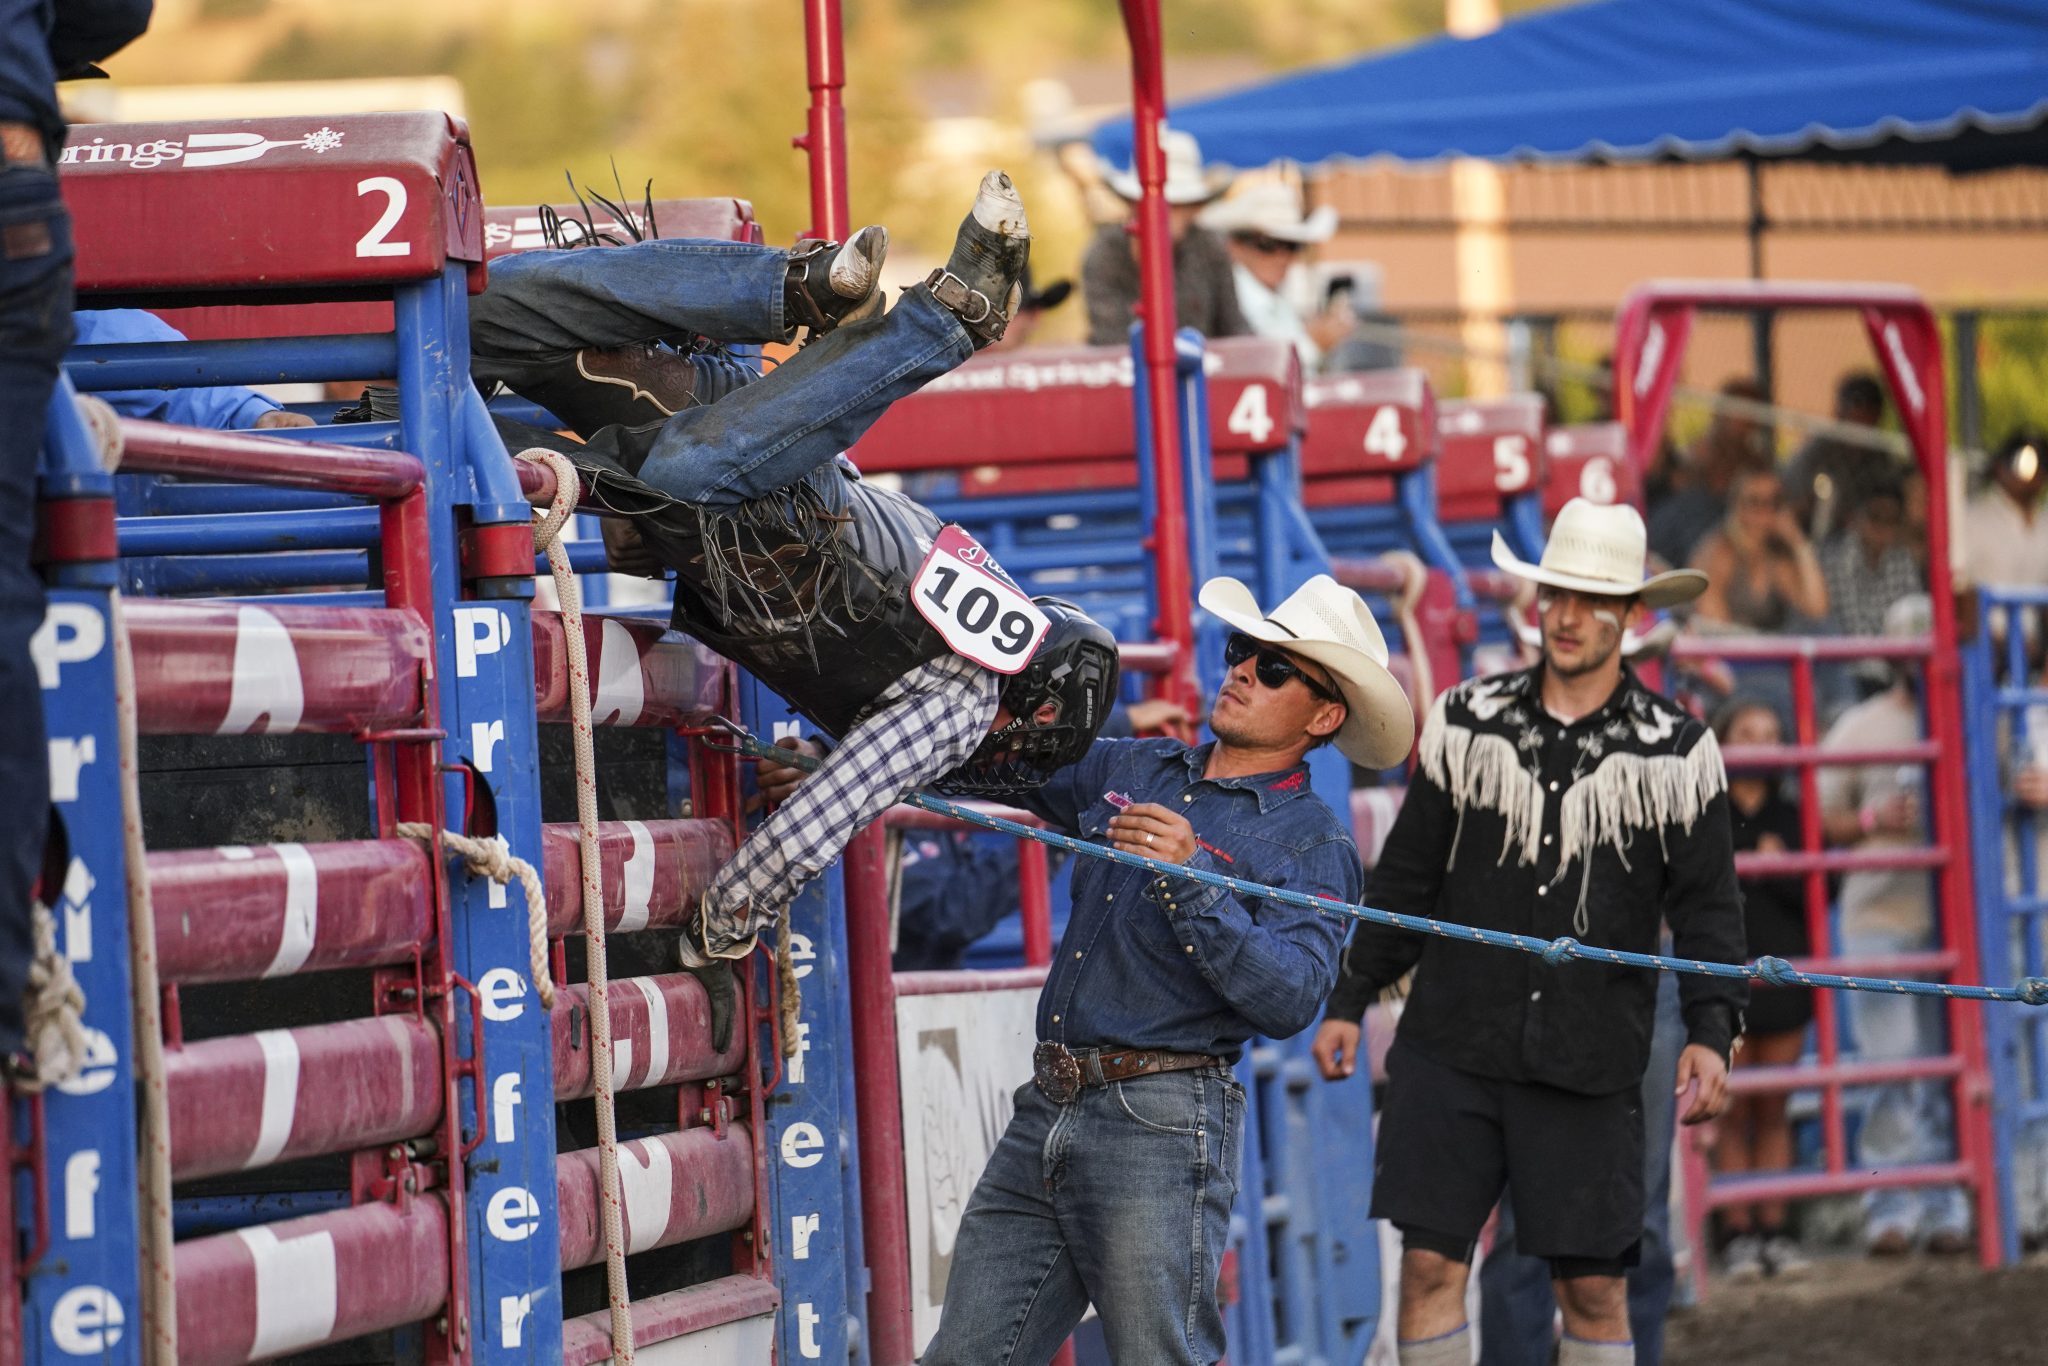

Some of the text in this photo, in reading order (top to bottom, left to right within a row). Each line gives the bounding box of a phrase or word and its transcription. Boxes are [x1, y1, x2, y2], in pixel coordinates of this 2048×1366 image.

[355, 177, 411, 258] 2
[1228, 384, 1274, 442] 4
[1364, 405, 1408, 461] 4
[1493, 435, 1530, 491] 5
[1579, 456, 1617, 504] 6
[923, 566, 1035, 655] 109
